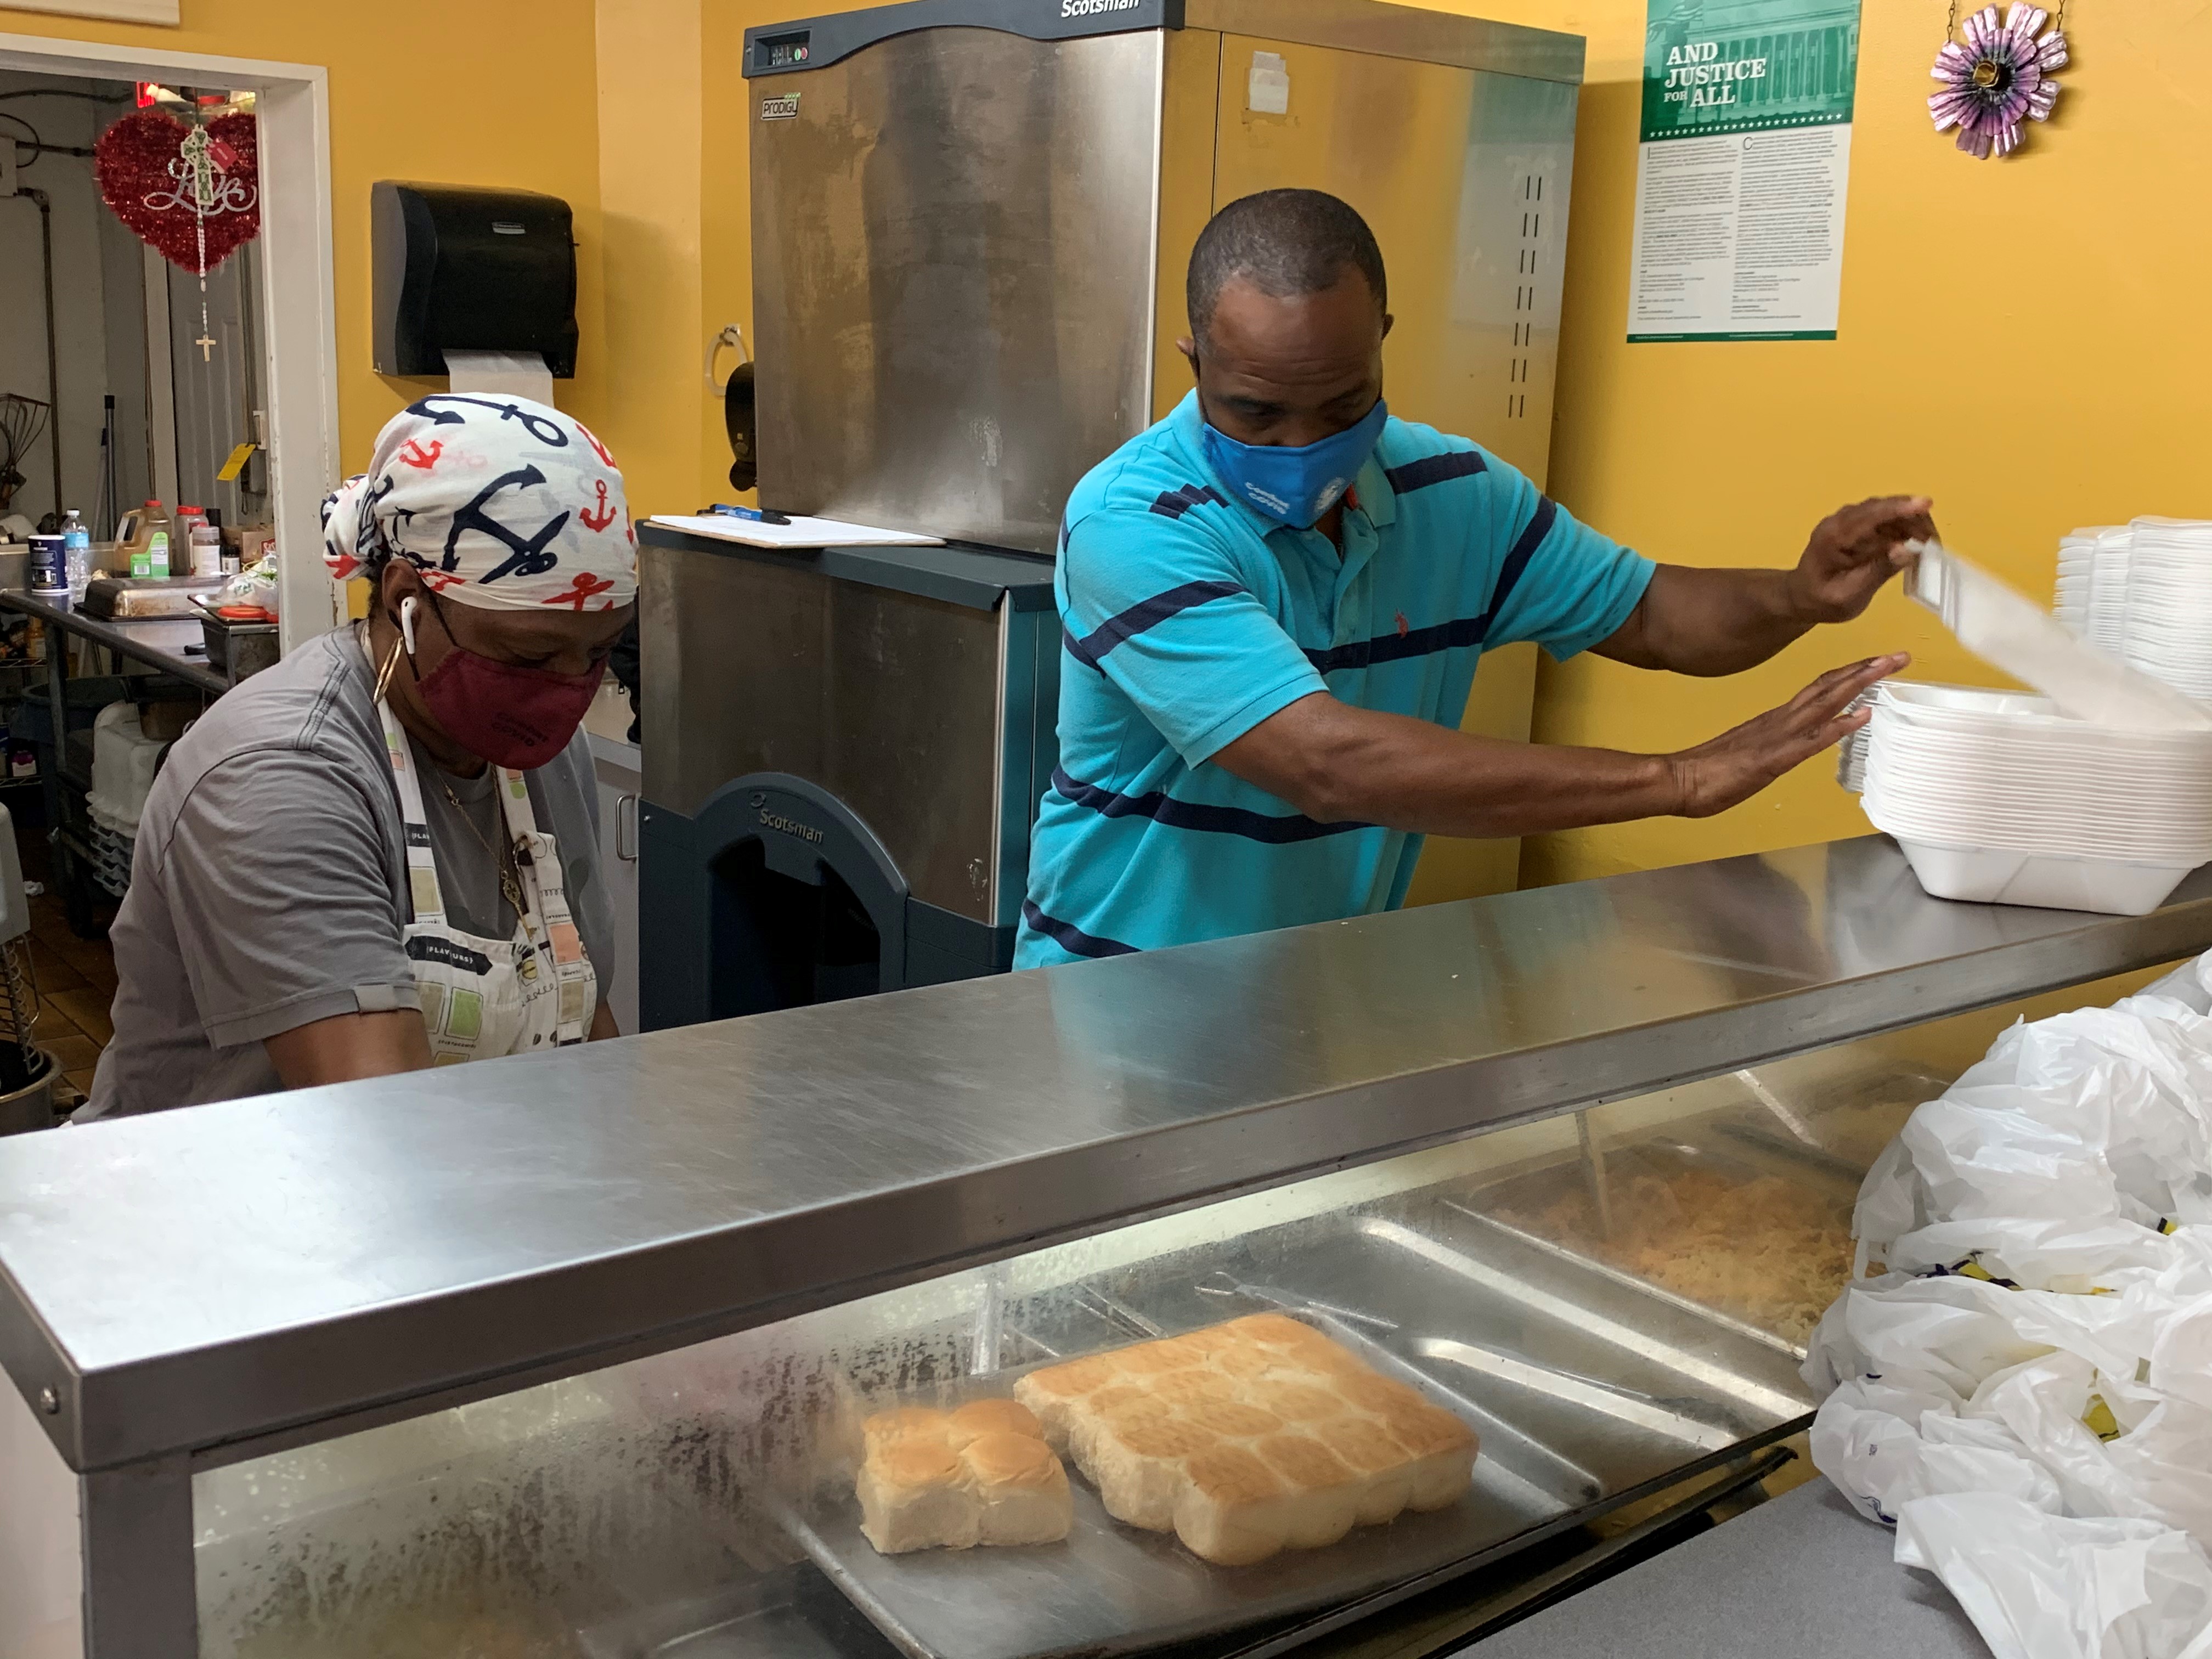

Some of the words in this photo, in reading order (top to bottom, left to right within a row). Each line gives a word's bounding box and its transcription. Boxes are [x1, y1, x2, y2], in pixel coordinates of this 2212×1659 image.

[1666, 42, 1718, 66] AND
[1664, 57, 1767, 88] JUSTICE
[1664, 91, 1688, 103] FOR
[1690, 85, 1736, 108] ALL
[760, 809, 823, 844] Scotsman
